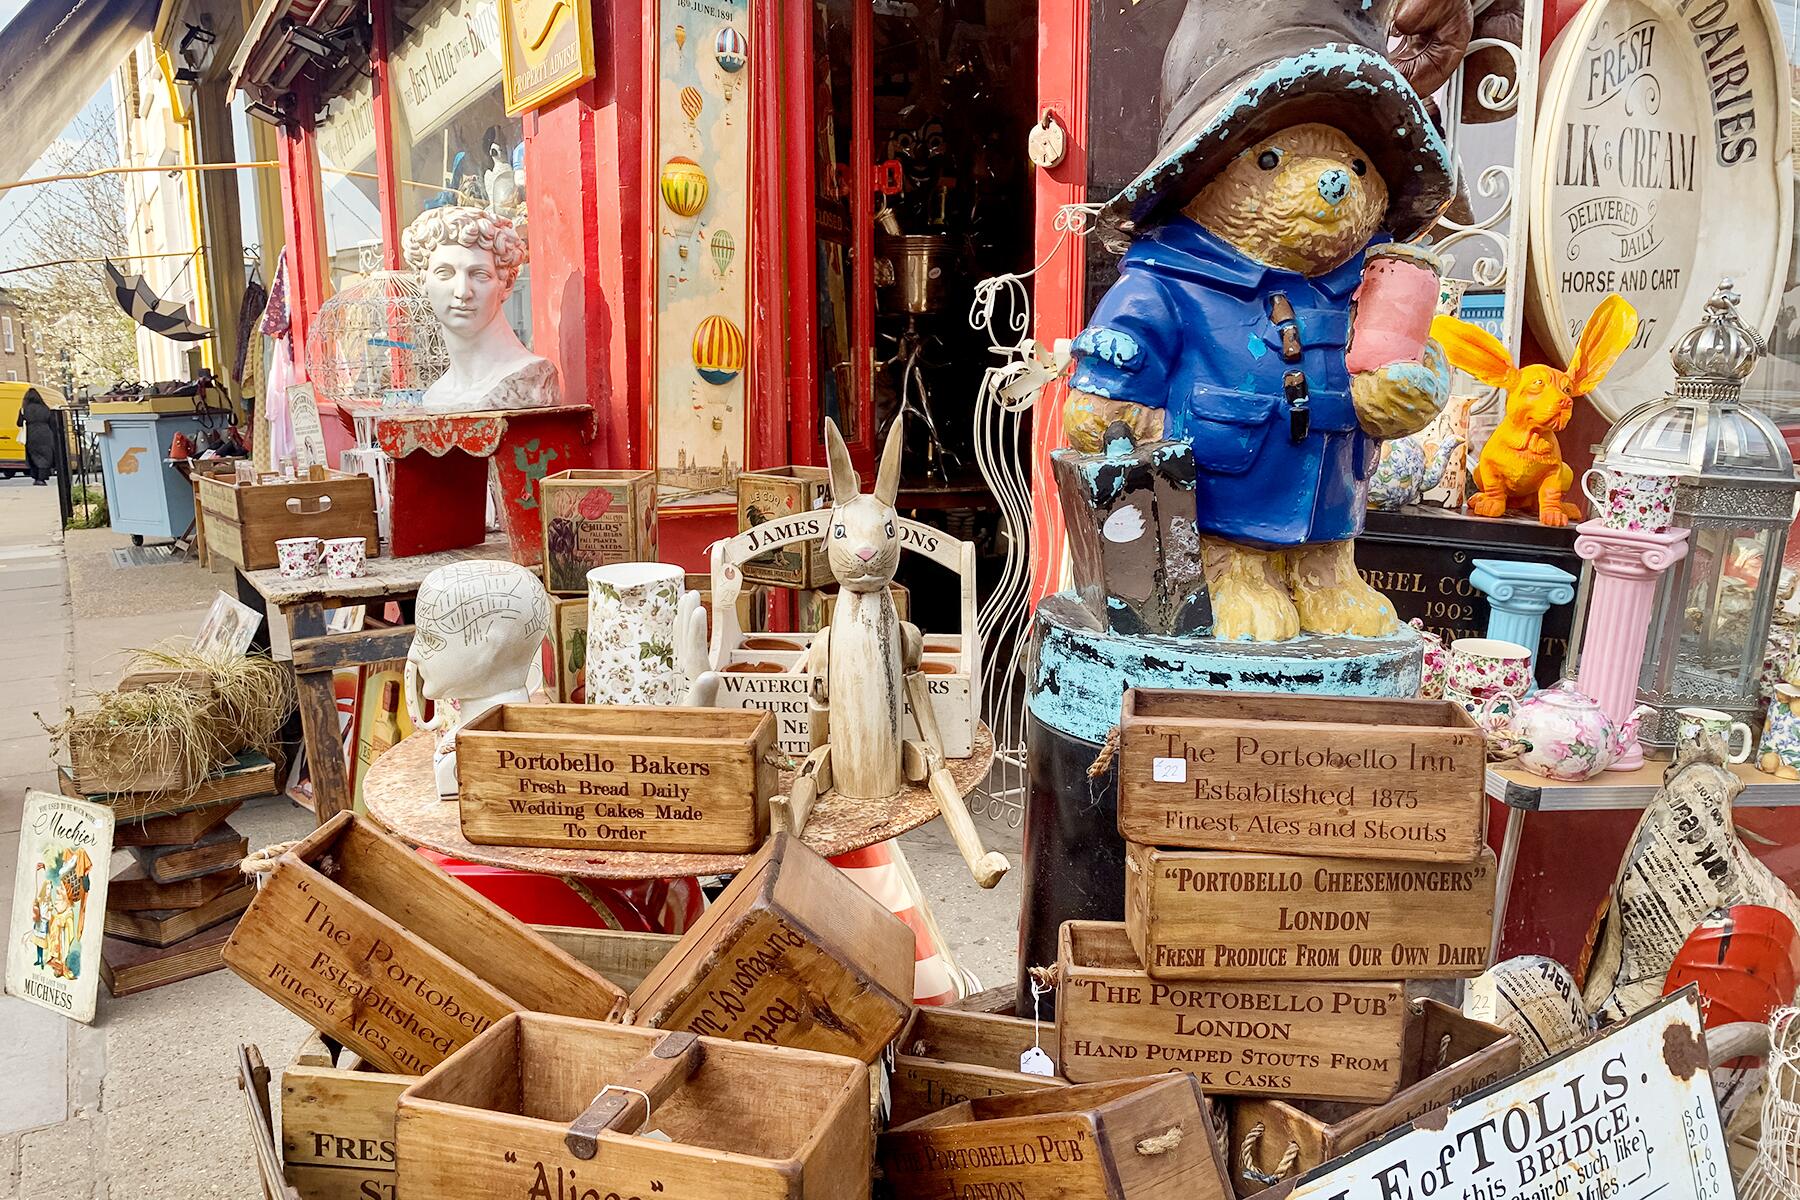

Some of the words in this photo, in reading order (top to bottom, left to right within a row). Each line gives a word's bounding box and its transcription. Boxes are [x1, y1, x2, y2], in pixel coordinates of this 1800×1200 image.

[717, 9, 733, 21] 1891
[409, 65, 432, 106] BEST
[426, 43, 457, 90] VALUE
[512, 61, 548, 97] PROPERTY
[1587, 26, 1655, 102] FRESH
[1690, 0, 1757, 166] DAIRIES
[352, 98, 375, 141] VICTO
[1604, 140, 1613, 170] &
[1618, 126, 1697, 192] CREAM
[1568, 200, 1638, 234] DELIVERED
[1621, 225, 1655, 258] DAILY
[1561, 270, 1616, 293] HORSE
[1619, 269, 1648, 292] AND
[1651, 269, 1680, 291] CART
[817, 483, 832, 503] PA
[747, 519, 821, 552] JAMES
[900, 526, 939, 552] ONS
[1439, 577, 1484, 598] CO
[1425, 601, 1473, 621] 1902
[723, 676, 809, 695] WATERC
[928, 681, 950, 695] RS
[742, 698, 809, 714] CHURC
[784, 720, 809, 734] NE
[497, 749, 615, 775] Portobello
[630, 754, 710, 777] Bakers
[1236, 735, 1398, 771] Portobello
[518, 778, 566, 795] Fresh
[579, 780, 629, 798] Bread
[642, 782, 691, 802] Daily
[1194, 777, 1355, 807] Established
[1371, 788, 1419, 810] 1875
[509, 800, 585, 820] Wedding
[595, 803, 645, 819] Cakes
[656, 804, 703, 821] Made
[1165, 810, 1239, 832] Finest
[1247, 815, 1300, 836] Ales
[1309, 819, 1355, 838] and
[1364, 820, 1447, 843] Stouts
[32, 811, 98, 848] Muchier
[563, 824, 587, 839] To
[597, 824, 647, 841] Order
[1278, 907, 1370, 931] LONDON
[730, 923, 806, 997] Purveyor
[1155, 943, 1205, 967] FRESH
[1214, 944, 1287, 967] PRODUCE
[1295, 944, 1339, 967] FROM
[1348, 943, 1383, 966] OUR
[1391, 943, 1429, 966] OWN
[1436, 943, 1487, 967] DAIRY
[24, 978, 73, 1011] MUCHNESS
[309, 952, 455, 1055] Established
[365, 939, 492, 1036] Portobell
[1151, 985, 1324, 1014] PORTOBELLO
[267, 961, 336, 1017] Finest
[341, 1013, 391, 1052] Ales
[1174, 1013, 1292, 1041] LONDON
[1073, 1040, 1138, 1060] HAND
[1145, 1043, 1230, 1065] PUMPED
[1241, 1048, 1320, 1069] STOUTS
[1330, 1053, 1389, 1073] FROM
[1224, 1069, 1292, 1089] CASKS
[314, 1133, 395, 1163] FRES
[924, 1143, 1036, 1171] PORTOBELLO
[1577, 1150, 1610, 1184] such
[1614, 1133, 1641, 1163] like
[1421, 1144, 1455, 1197] of
[949, 1178, 1026, 1200] LONDON
